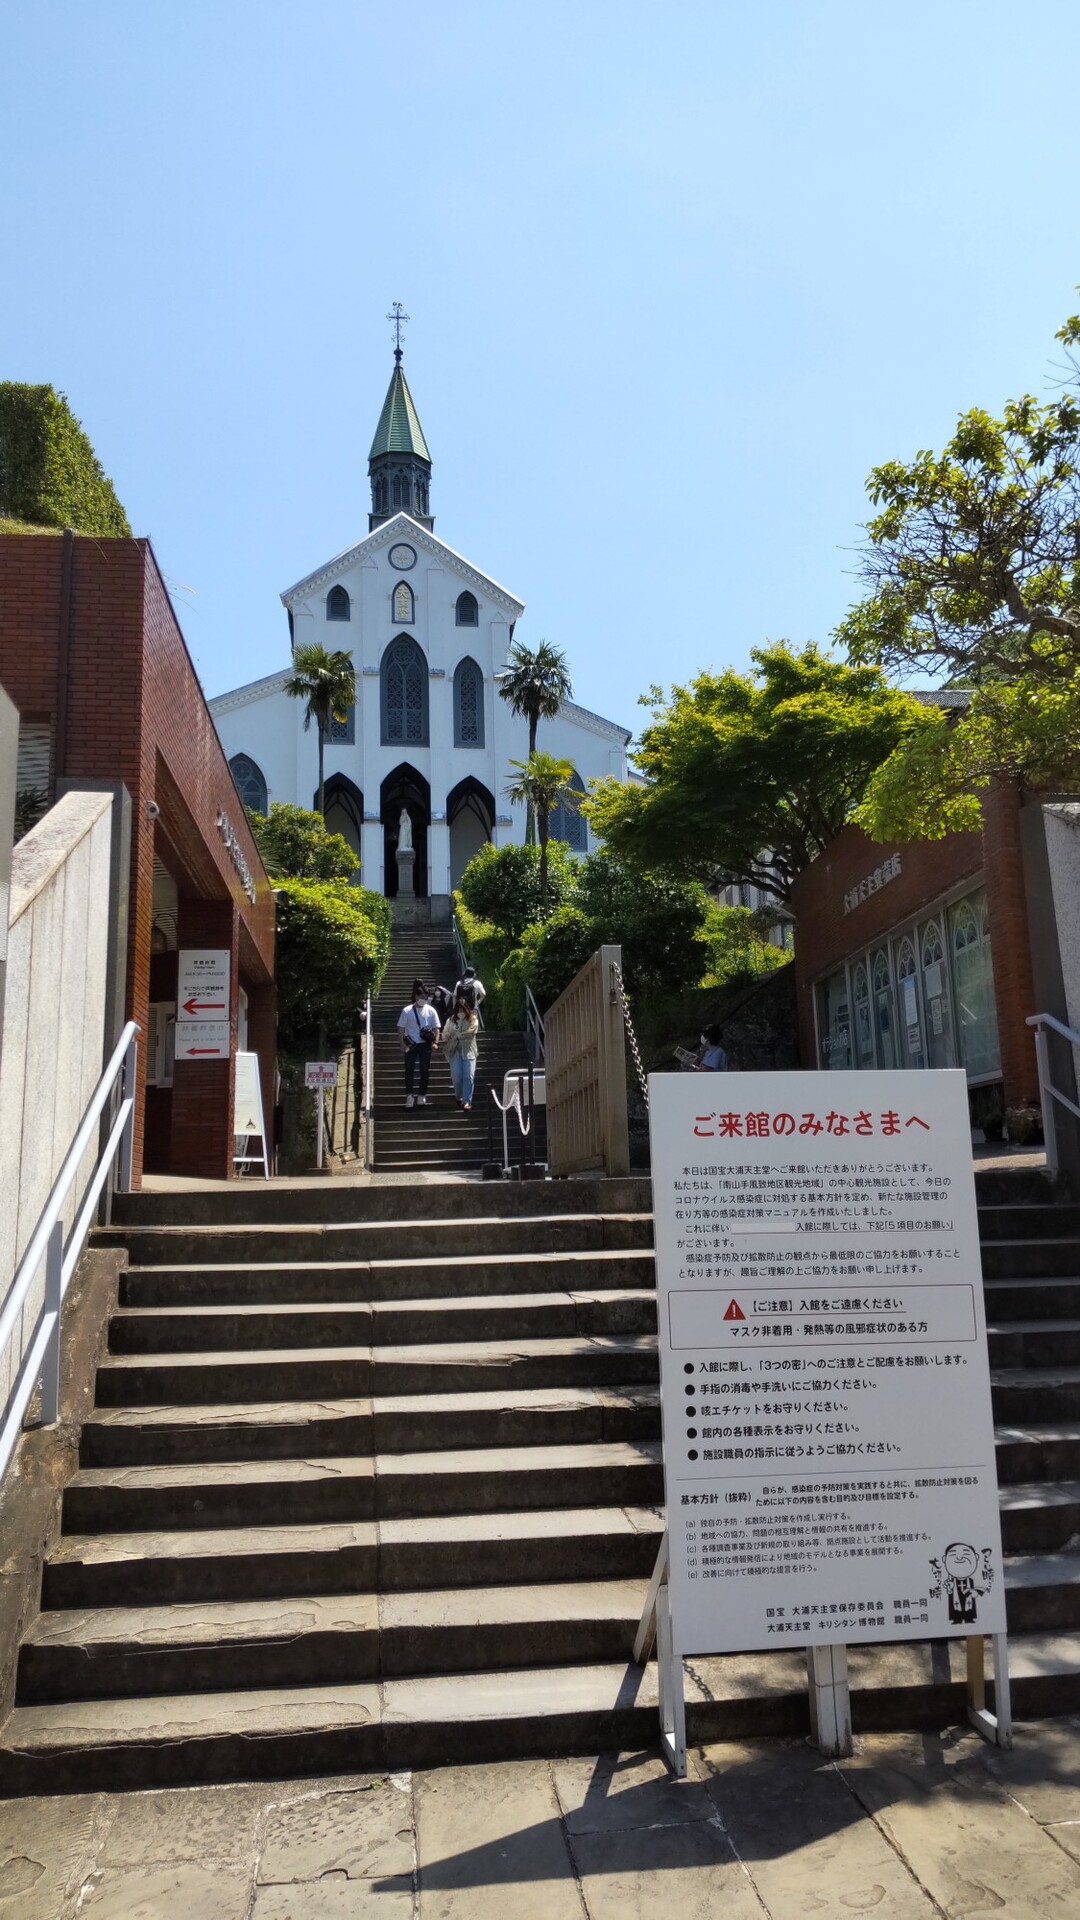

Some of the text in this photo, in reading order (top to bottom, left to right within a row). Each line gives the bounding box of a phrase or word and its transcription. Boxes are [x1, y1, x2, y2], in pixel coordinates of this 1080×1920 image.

[693, 1110, 931, 1138] ご来館のみなさまへ
[682, 1163, 933, 1176] 本日は国宝大浦天主堂へご来館いただきありがとうございます。
[674, 1177, 951, 1190] 私たちは、「南山手風致地区観光地域」の中心観光施設として、今日の
[675, 1191, 948, 1205] コロナウイルス感染症に対処する基本方針を定め、新たな施設管理の
[675, 1207, 893, 1220] 在り方等の感染症対策マニュアルを作成いたしました。
[685, 1223, 730, 1234] これに伴い
[677, 1238, 735, 1249] がございます。
[685, 1248, 961, 1263] 感染症予防及び拡散防止の観点から最低限のご協力をお願いすること
[679, 1264, 923, 1279] となりますが、趣旨ご理解の上ご協力をお願い申し上げます。
[730, 1321, 928, 1337] マスク非着用・発熱等の風邪症状のある方
[700, 1378, 877, 1395] 手指の消毒や手洗いにご協力ください。
[701, 1400, 849, 1417] 咳エチケットをお守りください。
[702, 1422, 860, 1439] 館内の各種表示をお守りください。
[703, 1442, 902, 1461] 施設職員の指示に従うようご協力ください。
[767, 1621, 811, 1634] 大浦天主堂
